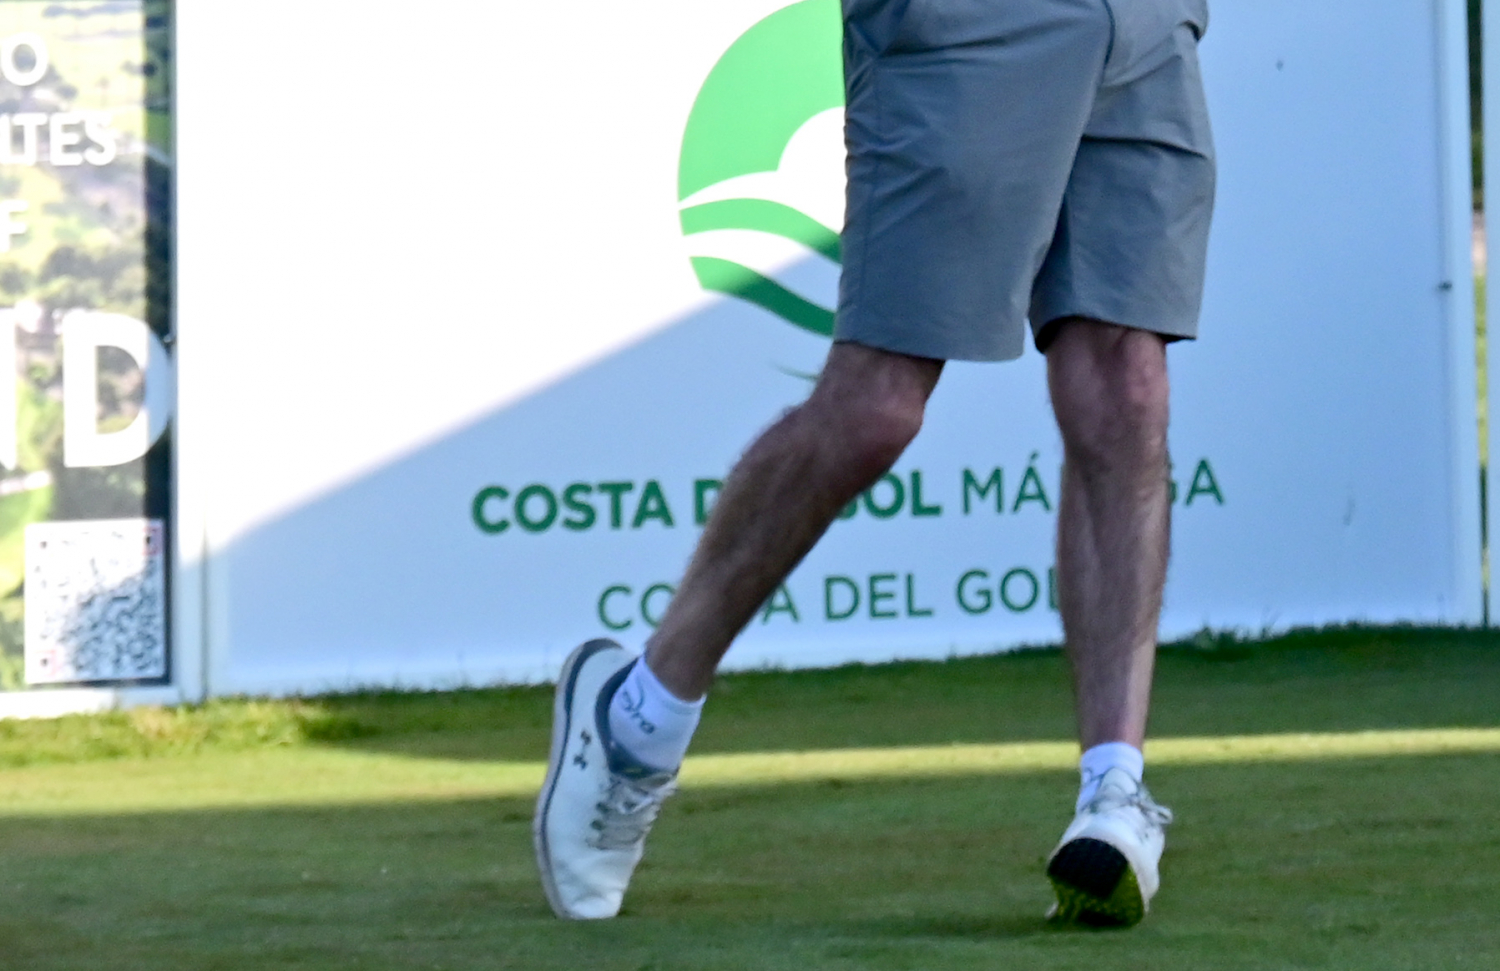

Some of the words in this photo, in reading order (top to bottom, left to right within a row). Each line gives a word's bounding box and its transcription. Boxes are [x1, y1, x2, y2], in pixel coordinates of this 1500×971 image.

[472, 480, 674, 534] COSTA
[598, 583, 799, 631] COA
[825, 573, 934, 621] DEL
